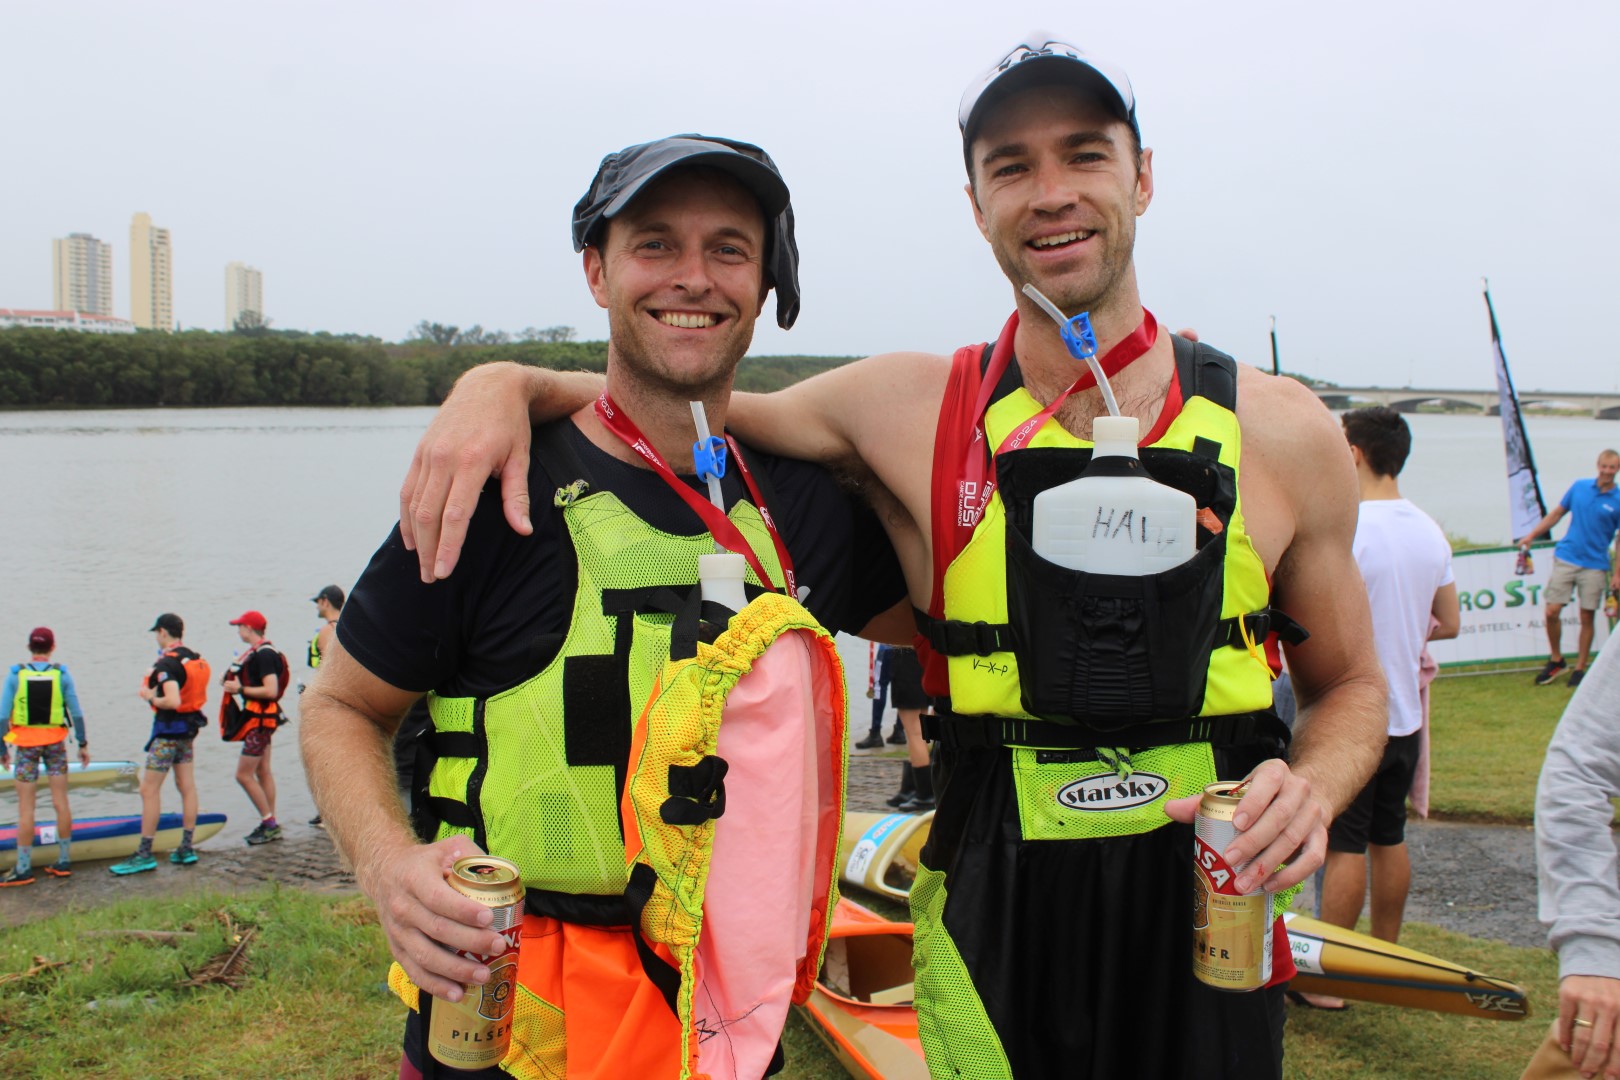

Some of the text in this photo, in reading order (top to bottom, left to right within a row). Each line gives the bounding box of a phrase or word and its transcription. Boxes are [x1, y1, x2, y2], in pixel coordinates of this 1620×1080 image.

[600, 393, 614, 418] 2024
[1010, 419, 1037, 448] 2024
[963, 481, 977, 527] DUSI
[1459, 589, 1496, 611] RO
[1479, 622, 1513, 632] STEEL
[1293, 957, 1311, 969] EEL
